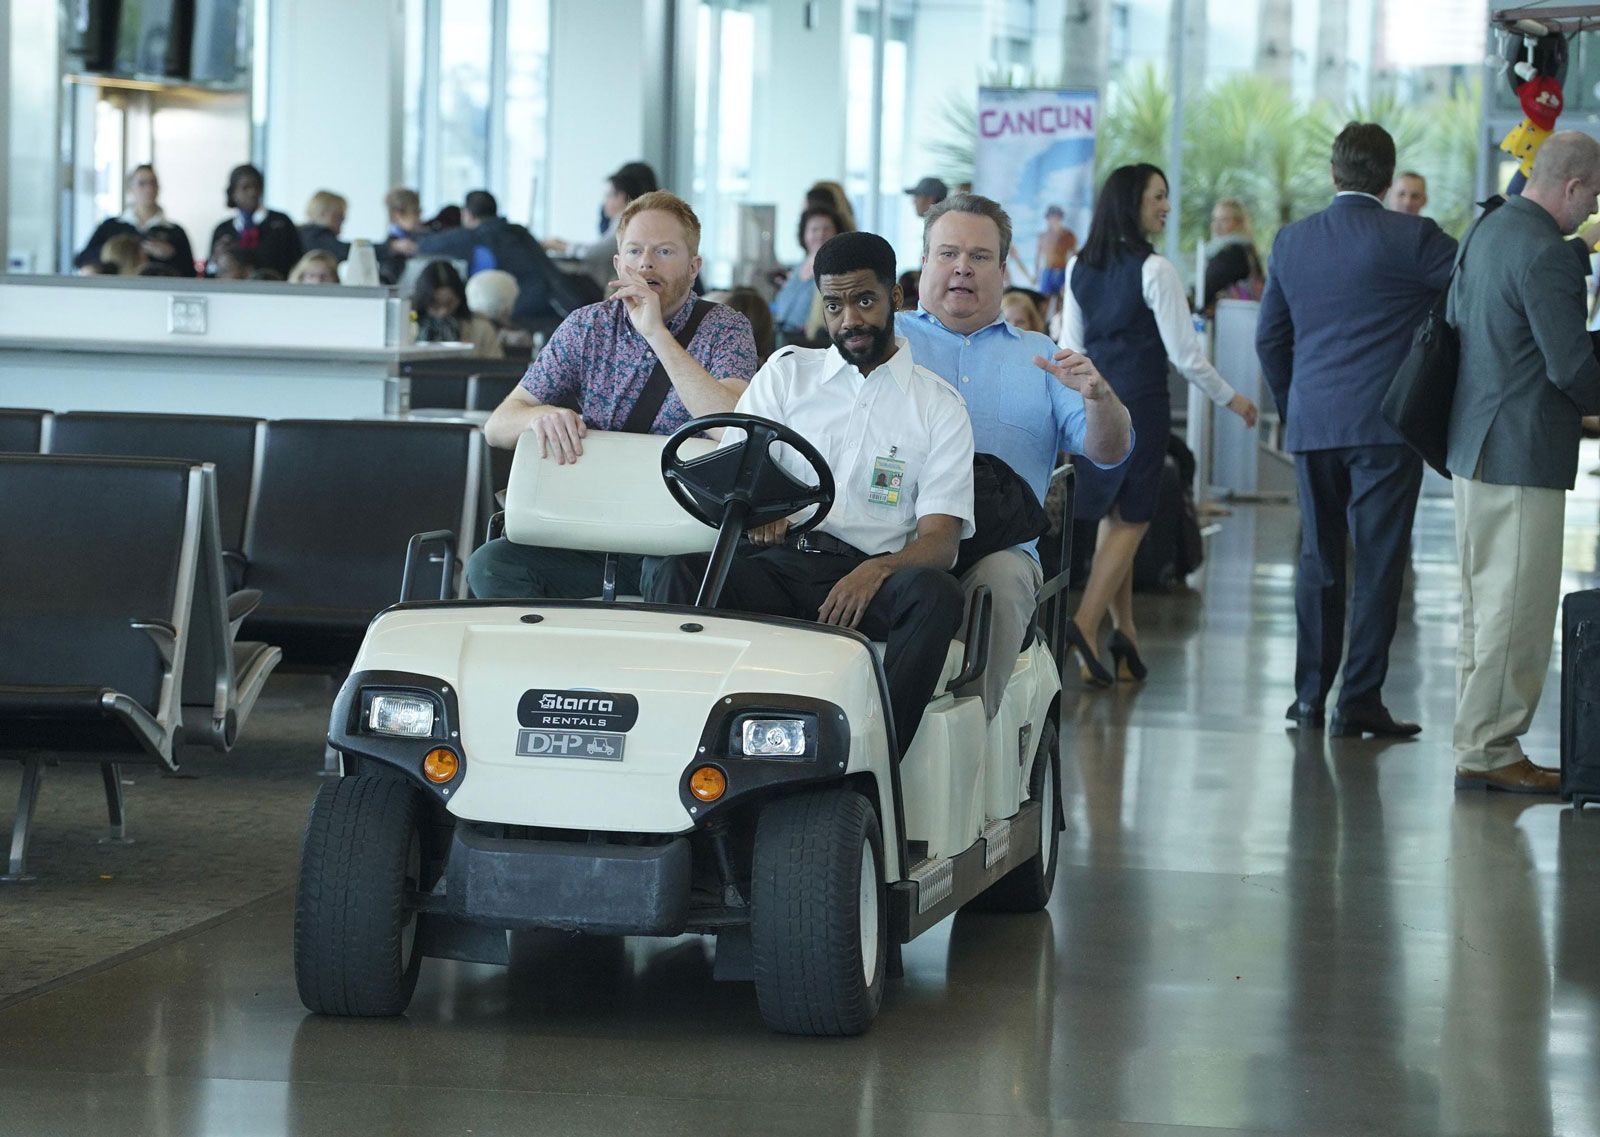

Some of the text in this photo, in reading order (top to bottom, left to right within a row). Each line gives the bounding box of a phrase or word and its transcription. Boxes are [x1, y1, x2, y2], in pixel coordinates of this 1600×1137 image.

[980, 105, 1093, 138] CANCUN
[539, 693, 614, 712] Starra
[542, 716, 607, 727] RENTALS
[527, 733, 583, 754] DHP
